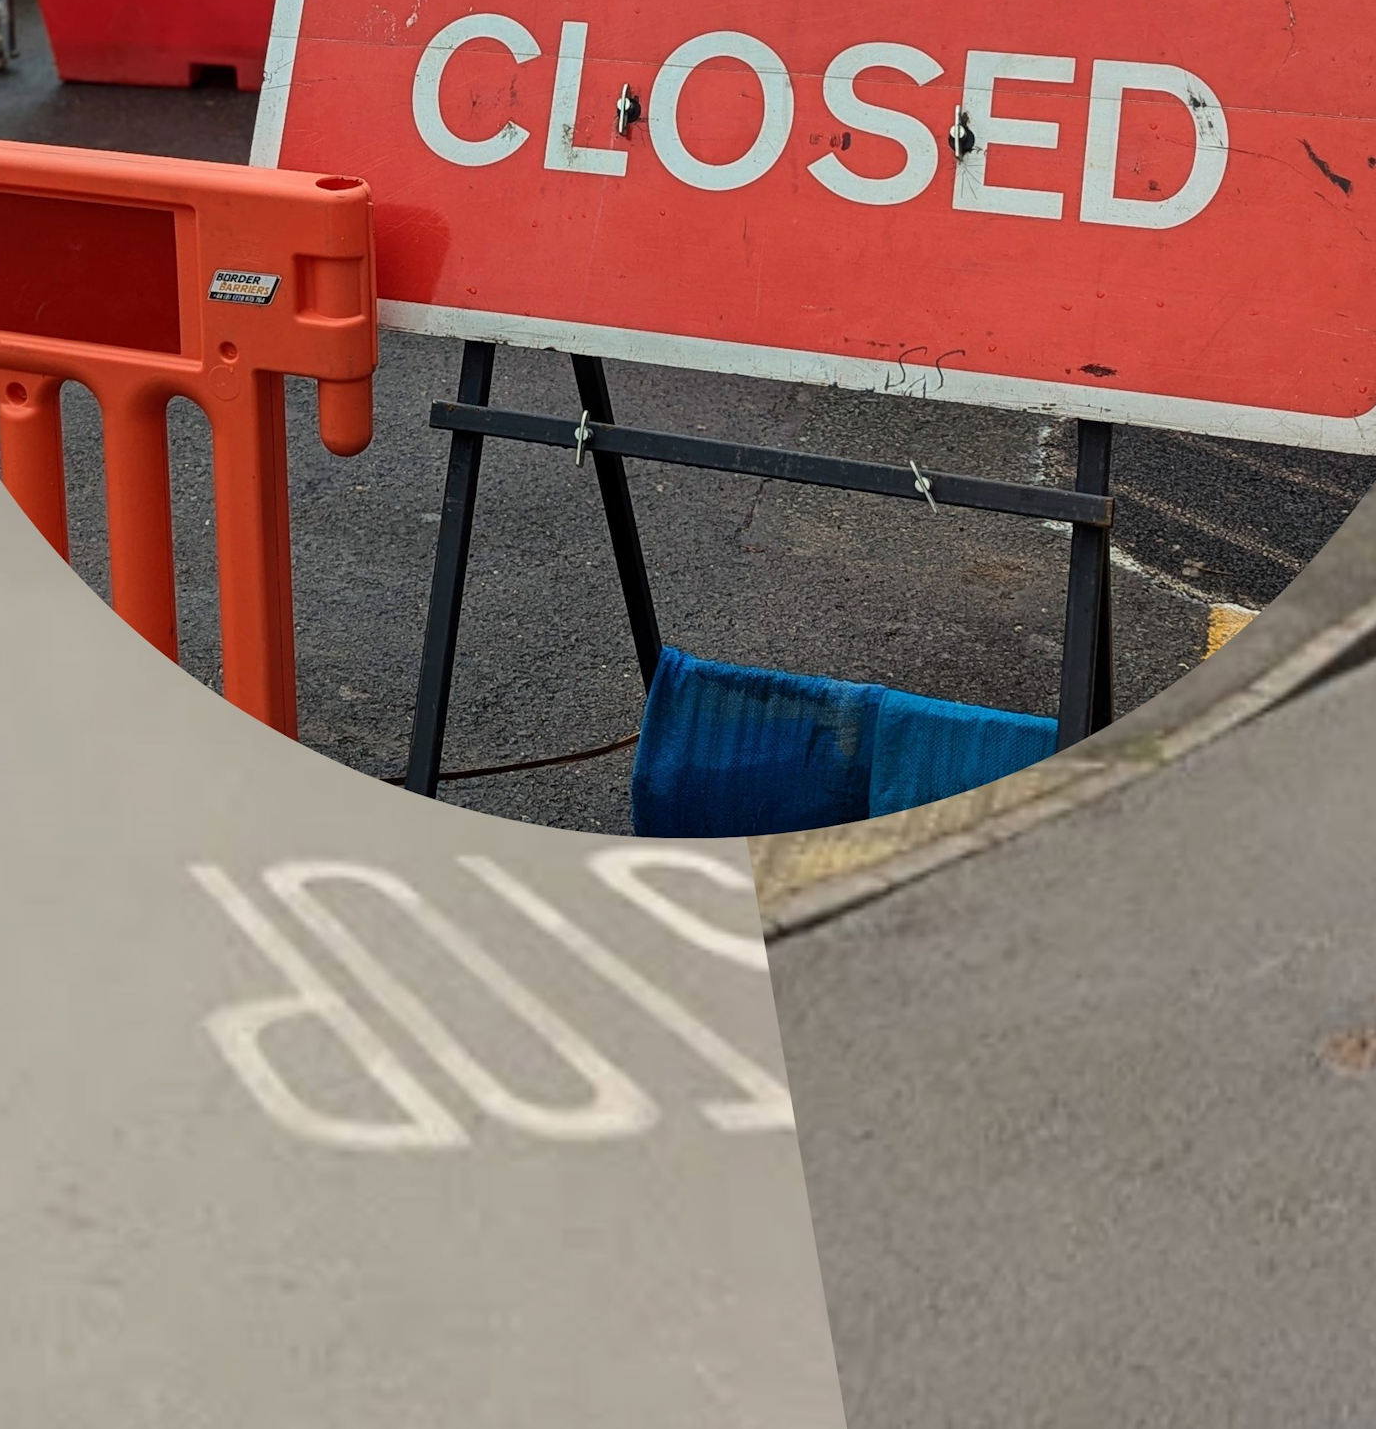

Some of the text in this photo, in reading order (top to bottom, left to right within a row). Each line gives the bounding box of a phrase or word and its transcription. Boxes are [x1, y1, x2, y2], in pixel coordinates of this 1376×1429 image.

[412, 13, 1229, 229] CLOSED
[216, 272, 261, 285] BORDER
[219, 281, 271, 295] BARRIERS
